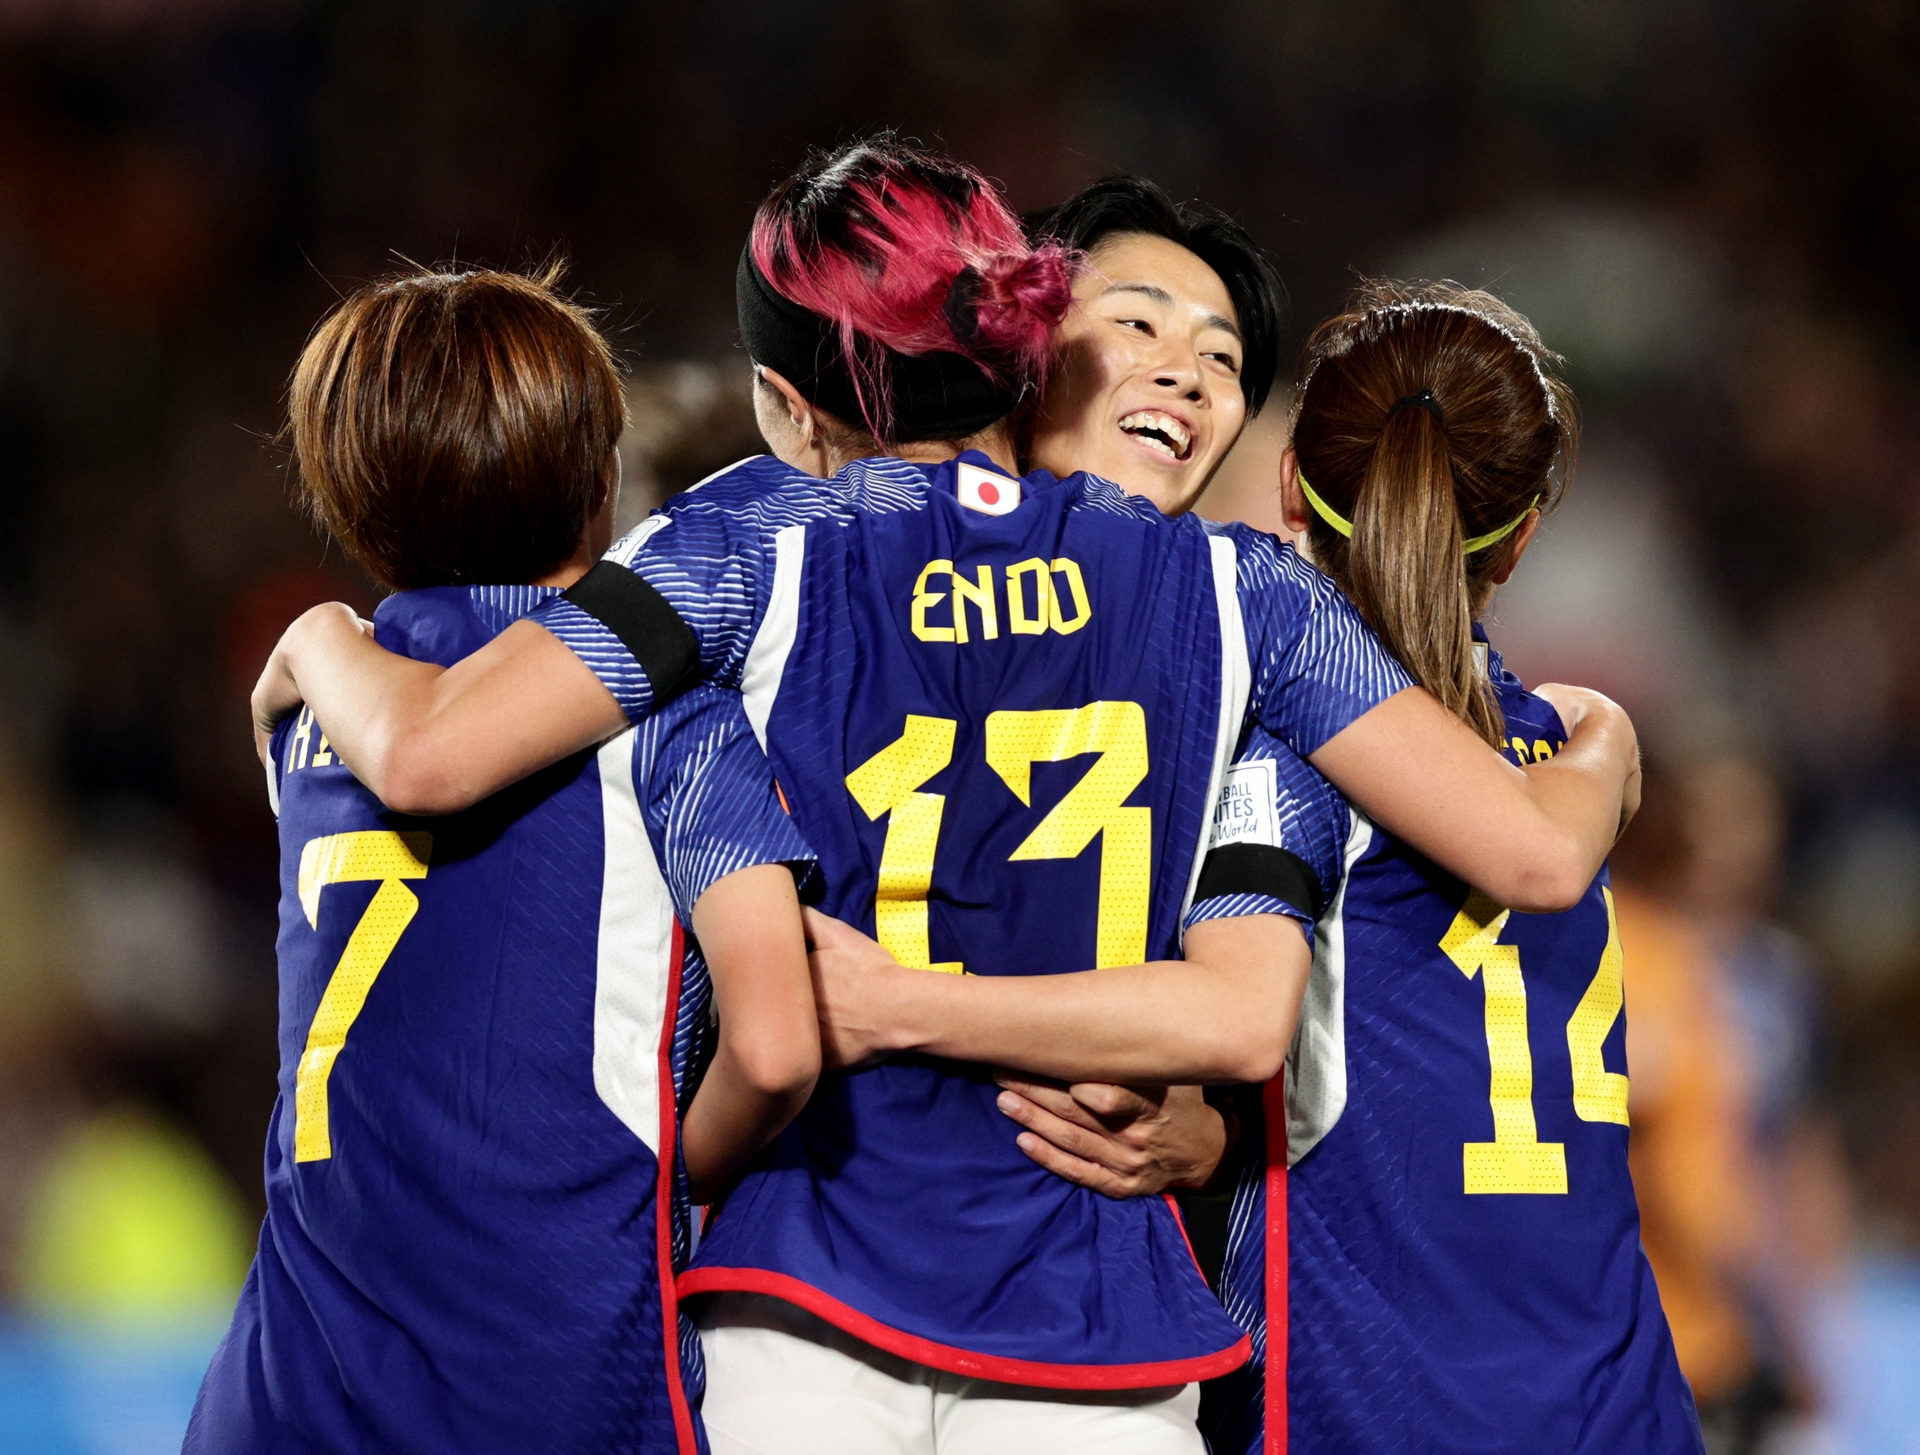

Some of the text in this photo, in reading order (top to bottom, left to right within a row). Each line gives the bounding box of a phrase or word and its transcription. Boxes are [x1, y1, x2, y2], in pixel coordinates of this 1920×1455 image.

[911, 557, 1092, 644] ENDO
[1217, 817, 1259, 840] World
[1219, 781, 1252, 801] BALL
[845, 701, 1152, 976] 13
[295, 830, 433, 1164] 7
